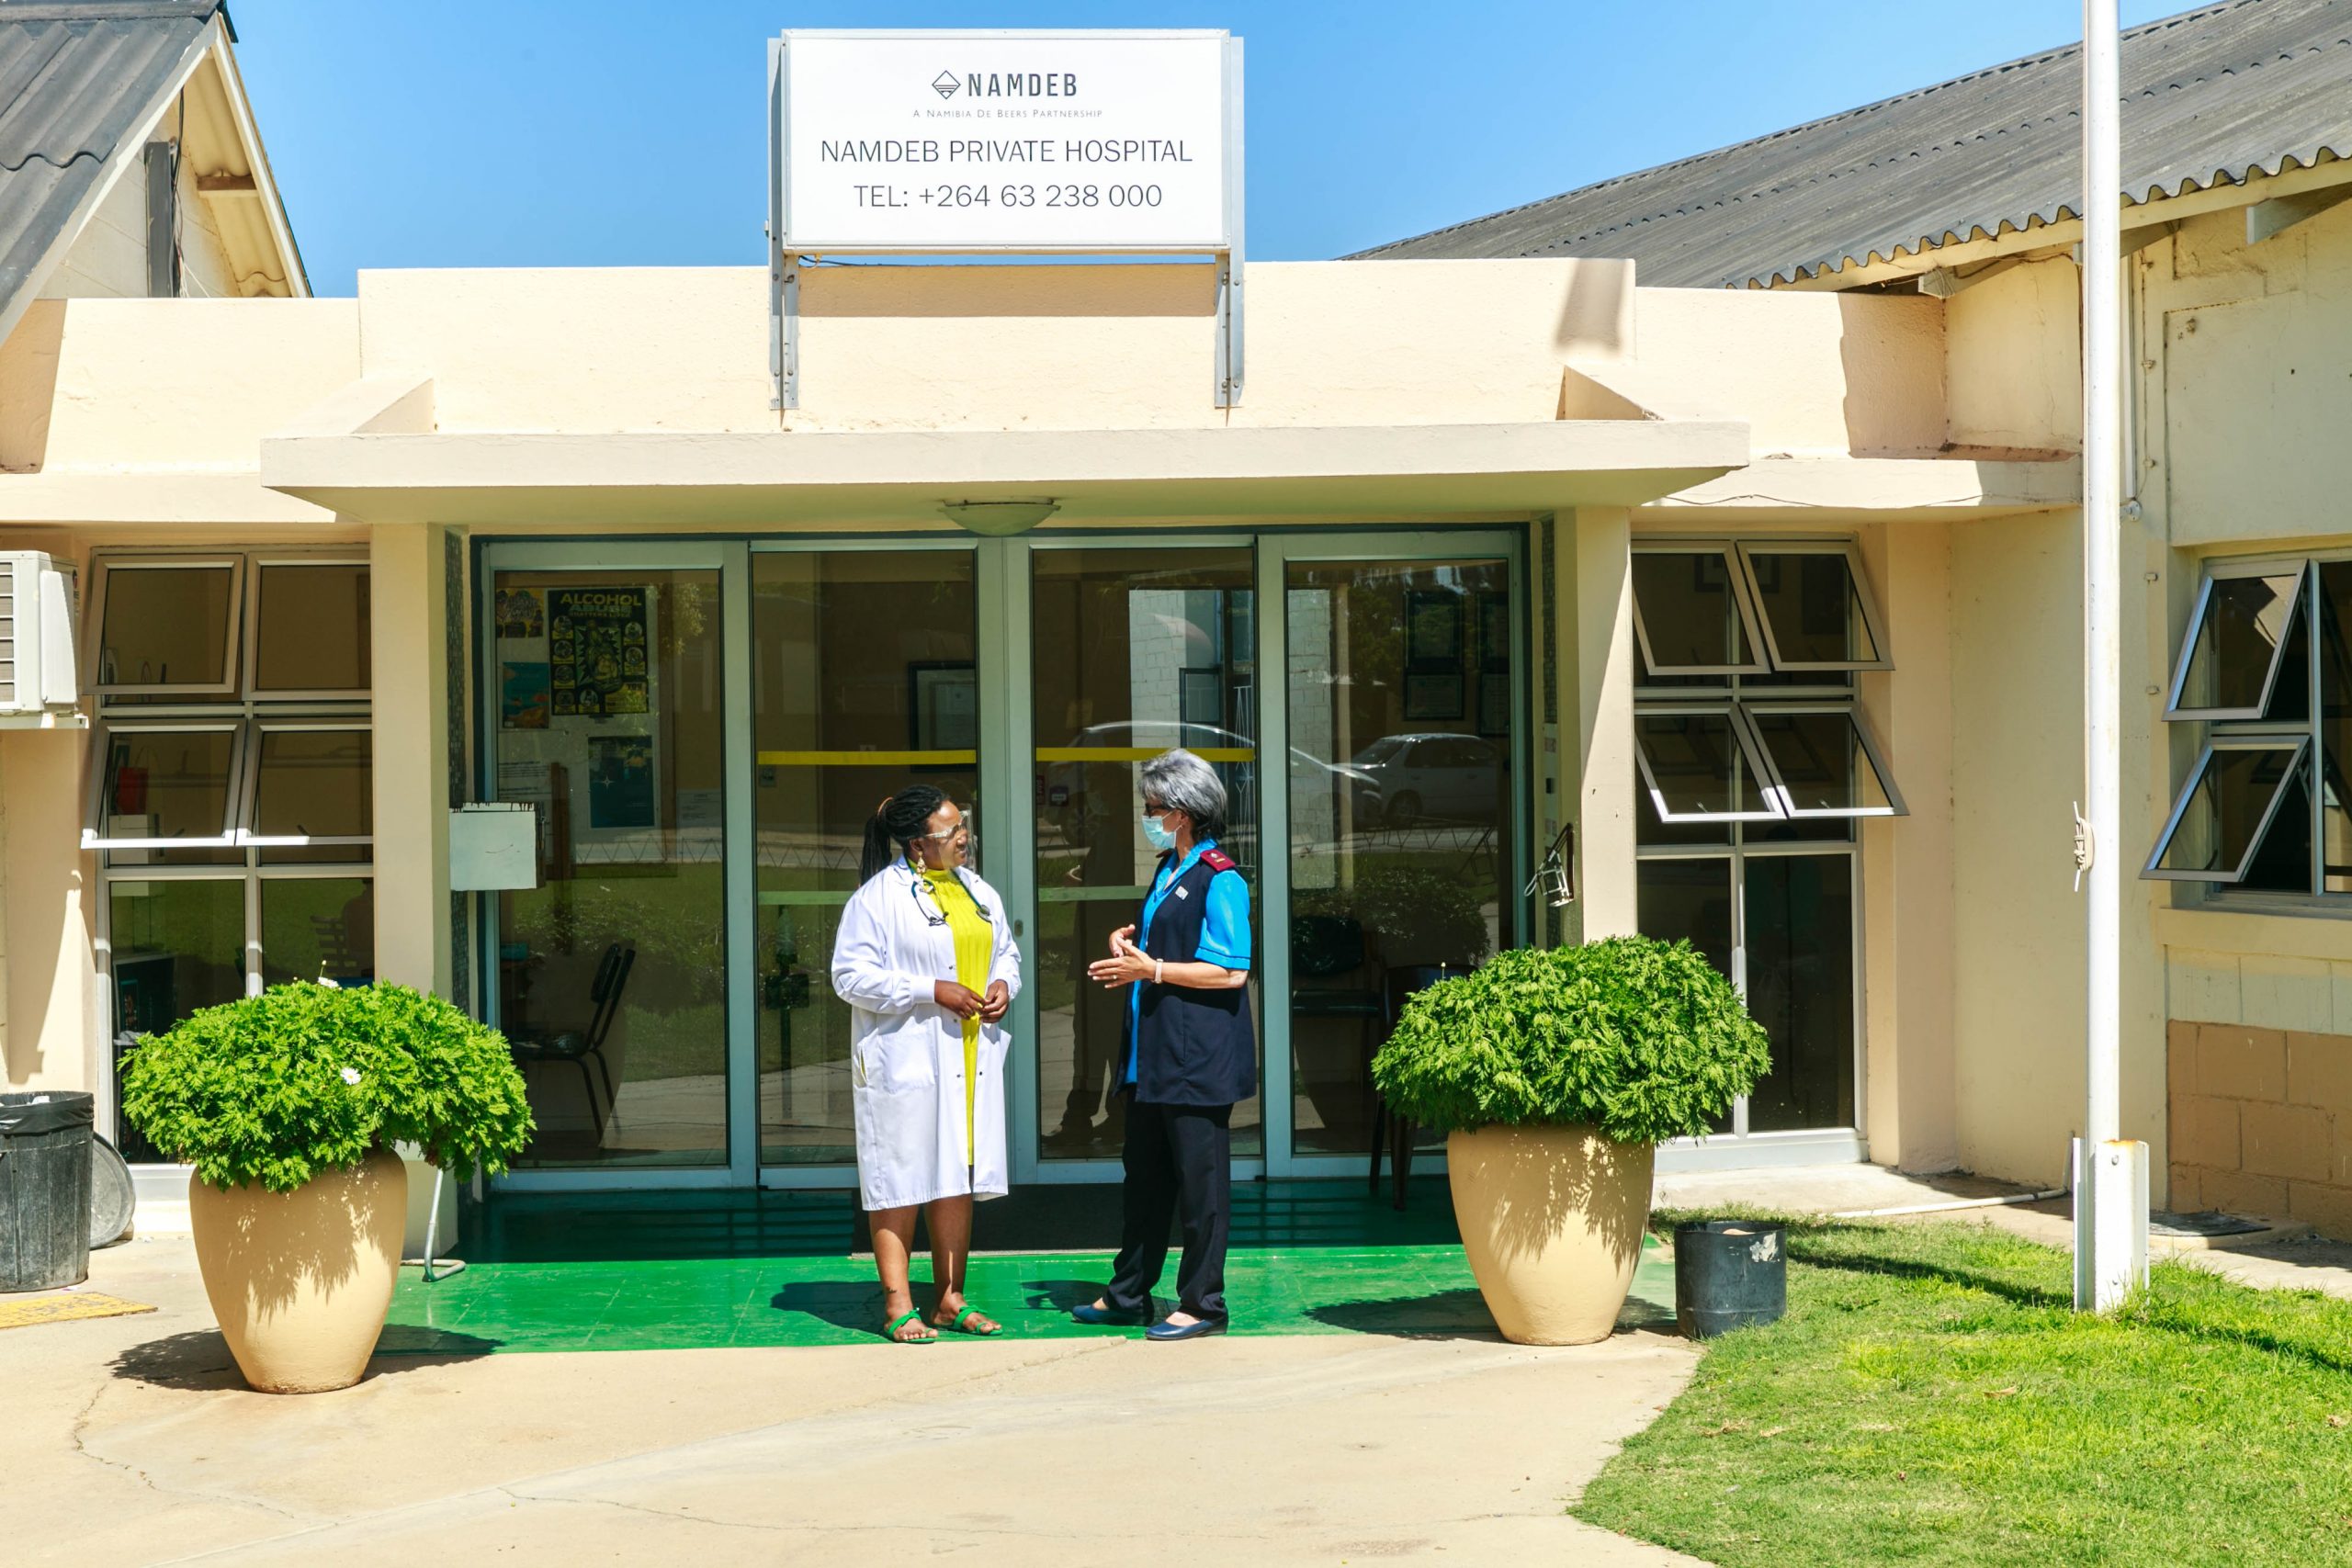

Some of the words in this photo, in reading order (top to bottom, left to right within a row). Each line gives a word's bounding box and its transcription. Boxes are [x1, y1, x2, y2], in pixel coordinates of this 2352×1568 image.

[967, 73, 1077, 97] NAMDEB
[913, 109, 921, 118] A
[926, 109, 972, 118] NAMIBIA
[977, 109, 991, 118] DE
[997, 109, 1027, 118] BEERS
[1033, 109, 1102, 118] PARTNERSHIP
[821, 140, 939, 163] NAMDEB
[950, 140, 1056, 163] PRIVATE
[1066, 140, 1193, 163] HOSPITAL
[853, 185, 908, 208] TEL:
[919, 185, 991, 208] +264
[1001, 185, 1035, 208] 63
[1046, 185, 1100, 208] 238
[1108, 185, 1162, 208] 000
[560, 592, 642, 606] ALCOHOL
